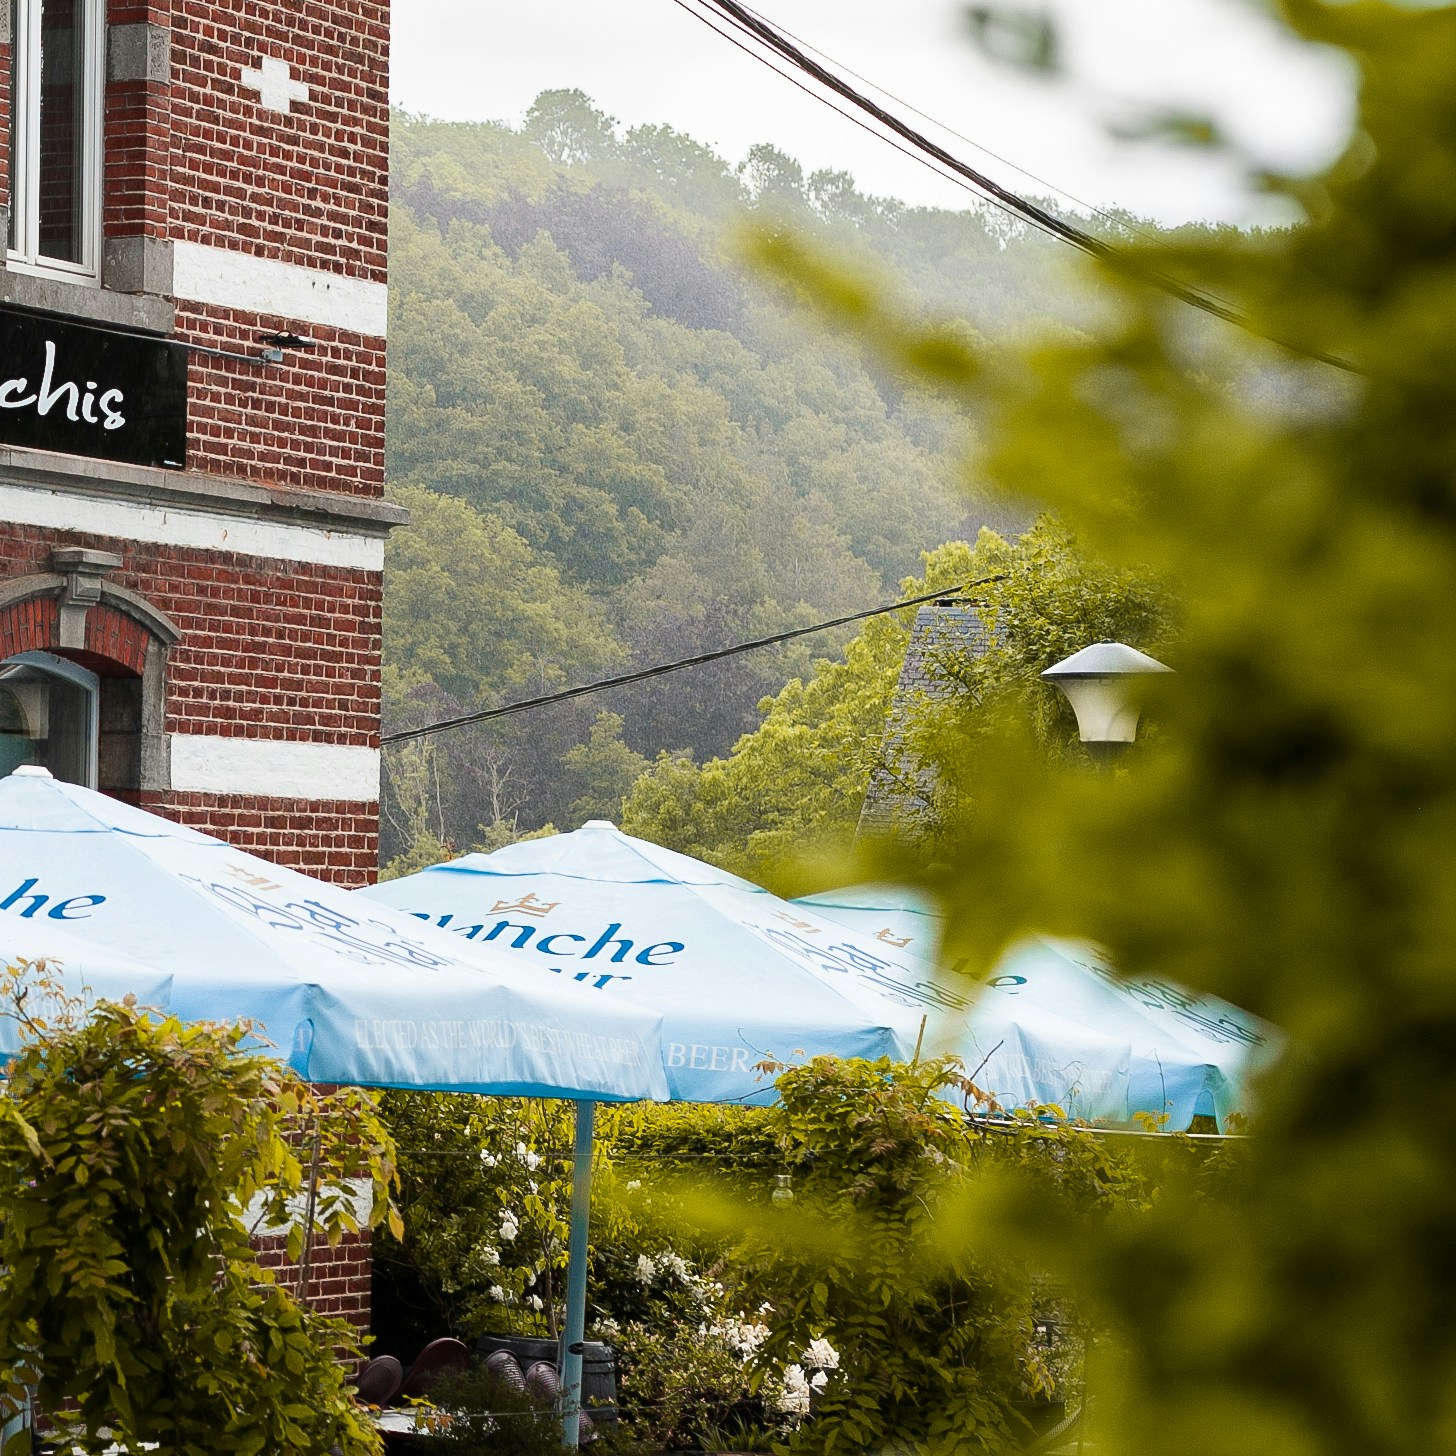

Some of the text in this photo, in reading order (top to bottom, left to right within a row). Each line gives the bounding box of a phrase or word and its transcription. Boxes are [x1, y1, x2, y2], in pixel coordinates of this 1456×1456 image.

[354, 1018, 418, 1050] ELECTED
[421, 1019, 440, 1050] AS
[441, 1020, 466, 1050] THE
[667, 1042, 750, 1074] BEER
